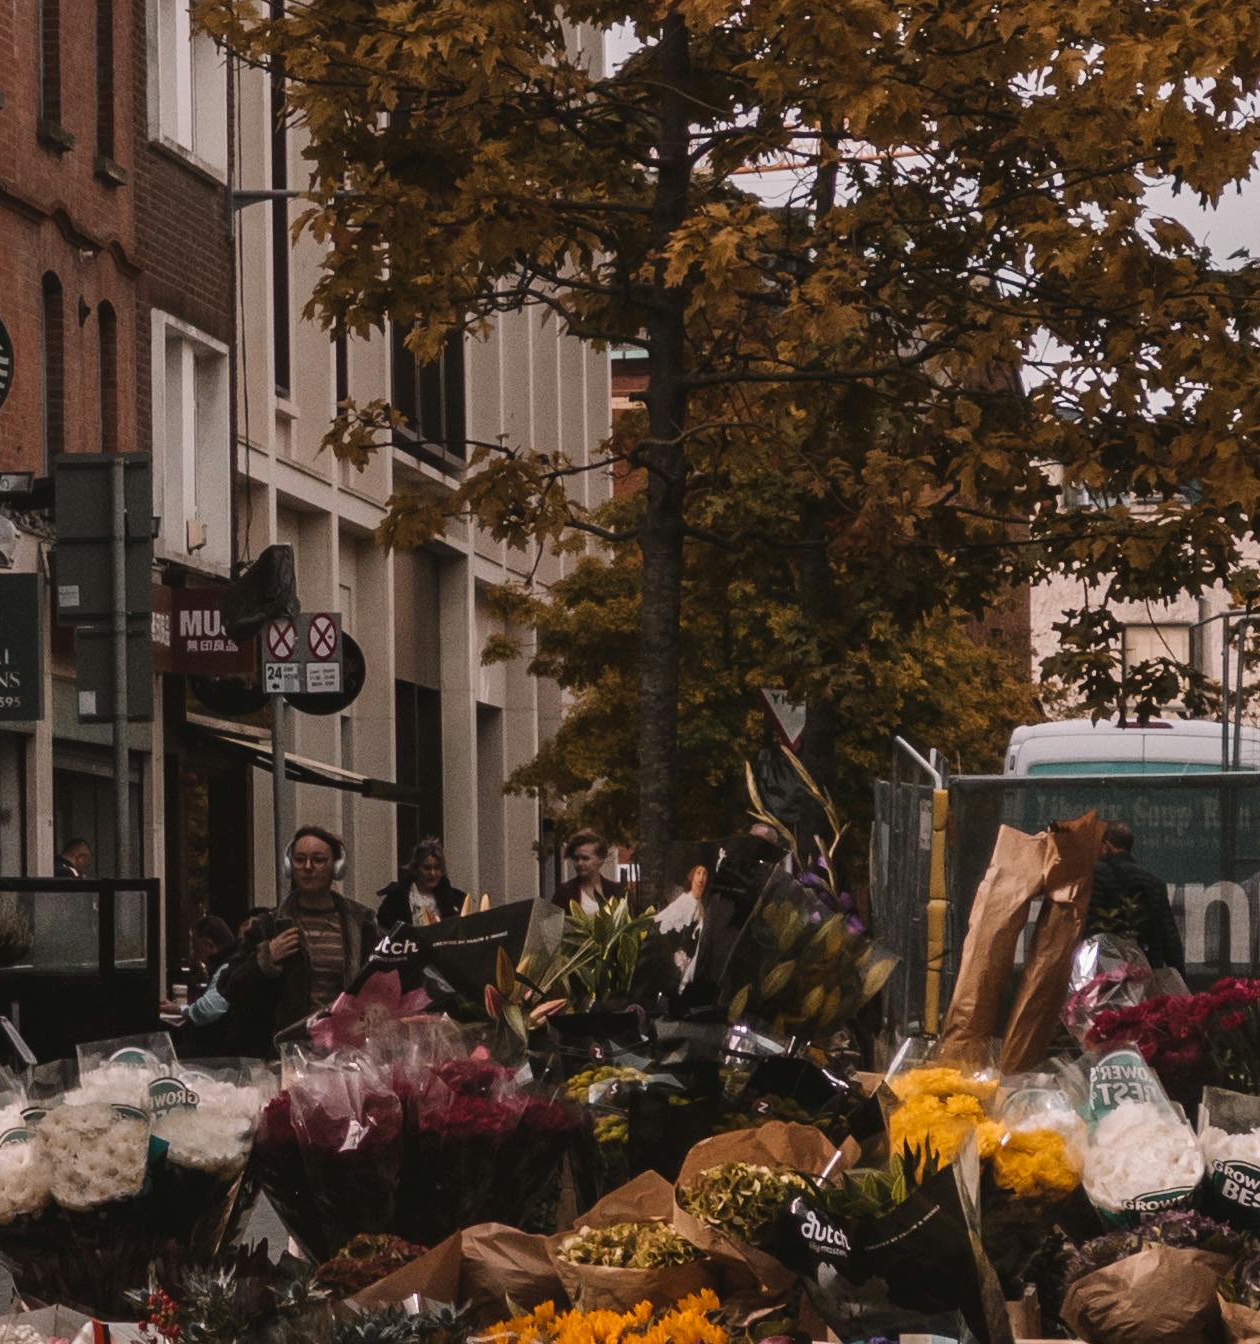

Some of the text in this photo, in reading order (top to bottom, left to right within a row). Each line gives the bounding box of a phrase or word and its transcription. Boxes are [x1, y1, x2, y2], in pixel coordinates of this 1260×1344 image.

[179, 609, 227, 638] MU
[267, 666, 282, 681] 24
[800, 1209, 852, 1251] dutch
